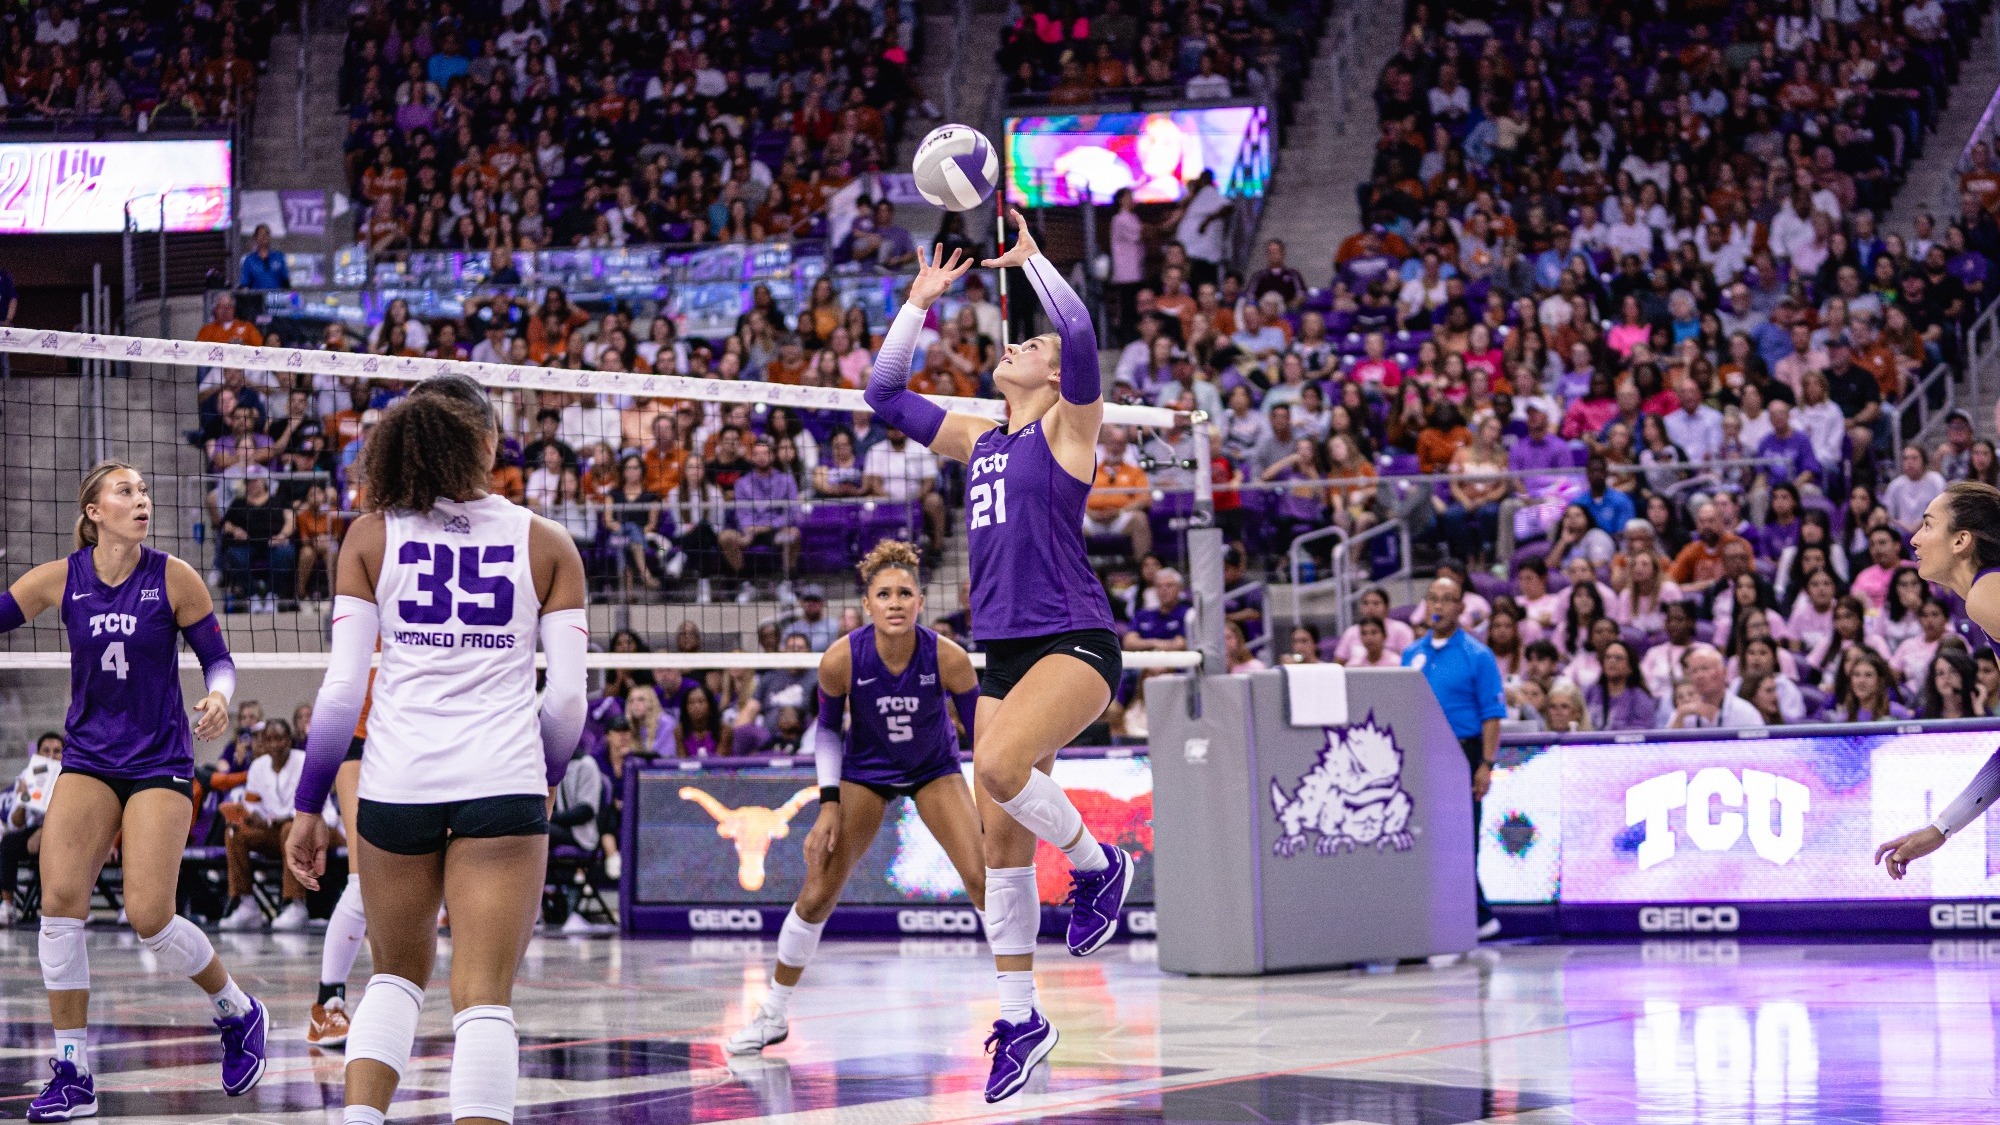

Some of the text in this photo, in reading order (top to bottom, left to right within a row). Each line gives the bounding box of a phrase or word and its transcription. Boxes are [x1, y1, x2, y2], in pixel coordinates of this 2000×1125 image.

[971, 452, 1009, 482] TCU
[970, 478, 1007, 530] 21
[398, 541, 515, 626] 35
[90, 612, 137, 637] TCU
[394, 631, 516, 648] HORNED FROGS
[101, 641, 130, 680] 4
[876, 695, 920, 715] TCU
[886, 715, 914, 743] 5
[1625, 766, 1811, 870] TCU
[688, 908, 763, 931] GEICO
[897, 909, 977, 932] GEICO
[1638, 906, 1740, 932] GEICO
[1929, 903, 2000, 930] GEIC
